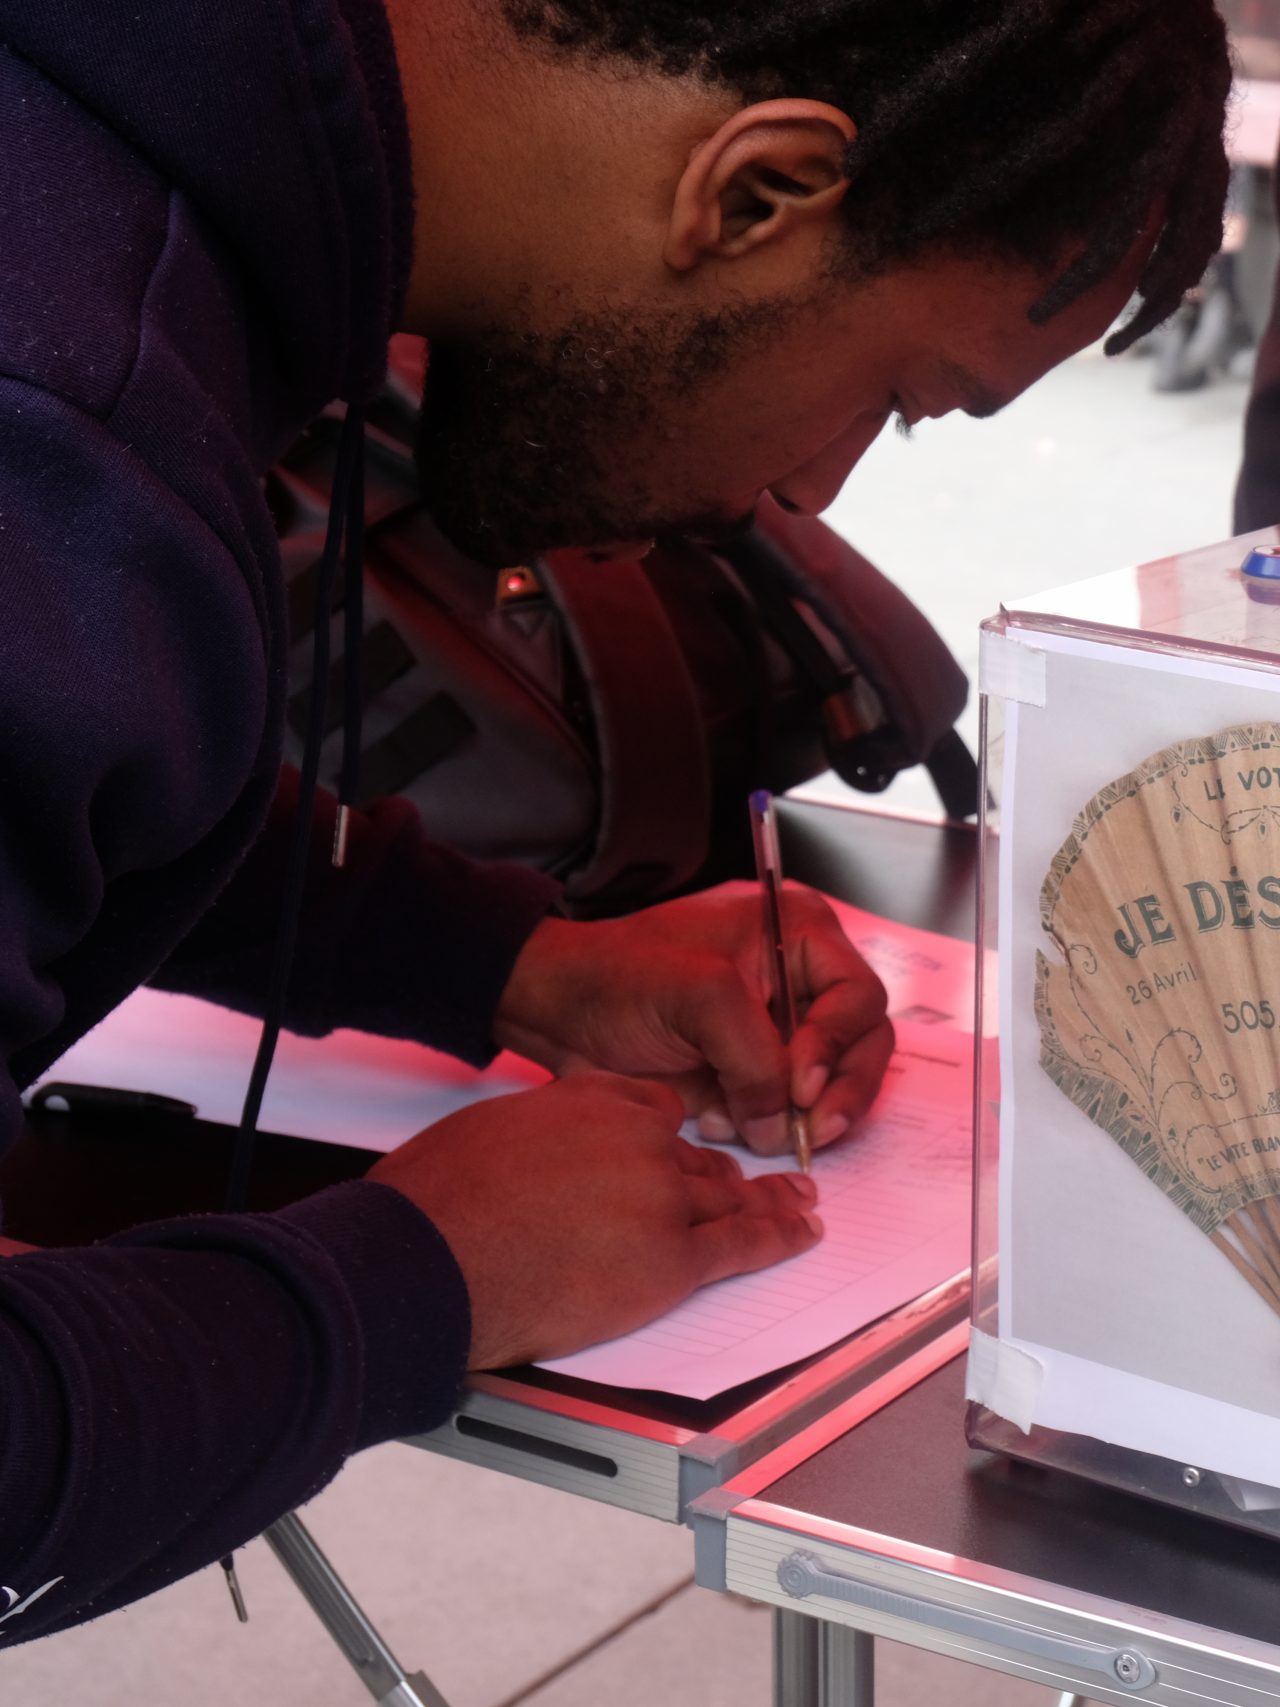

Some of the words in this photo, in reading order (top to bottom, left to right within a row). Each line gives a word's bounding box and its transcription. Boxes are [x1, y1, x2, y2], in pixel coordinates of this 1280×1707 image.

[1113, 894, 1177, 959] JE
[1126, 980, 1152, 1005] 26
[1153, 961, 1197, 993] Avril
